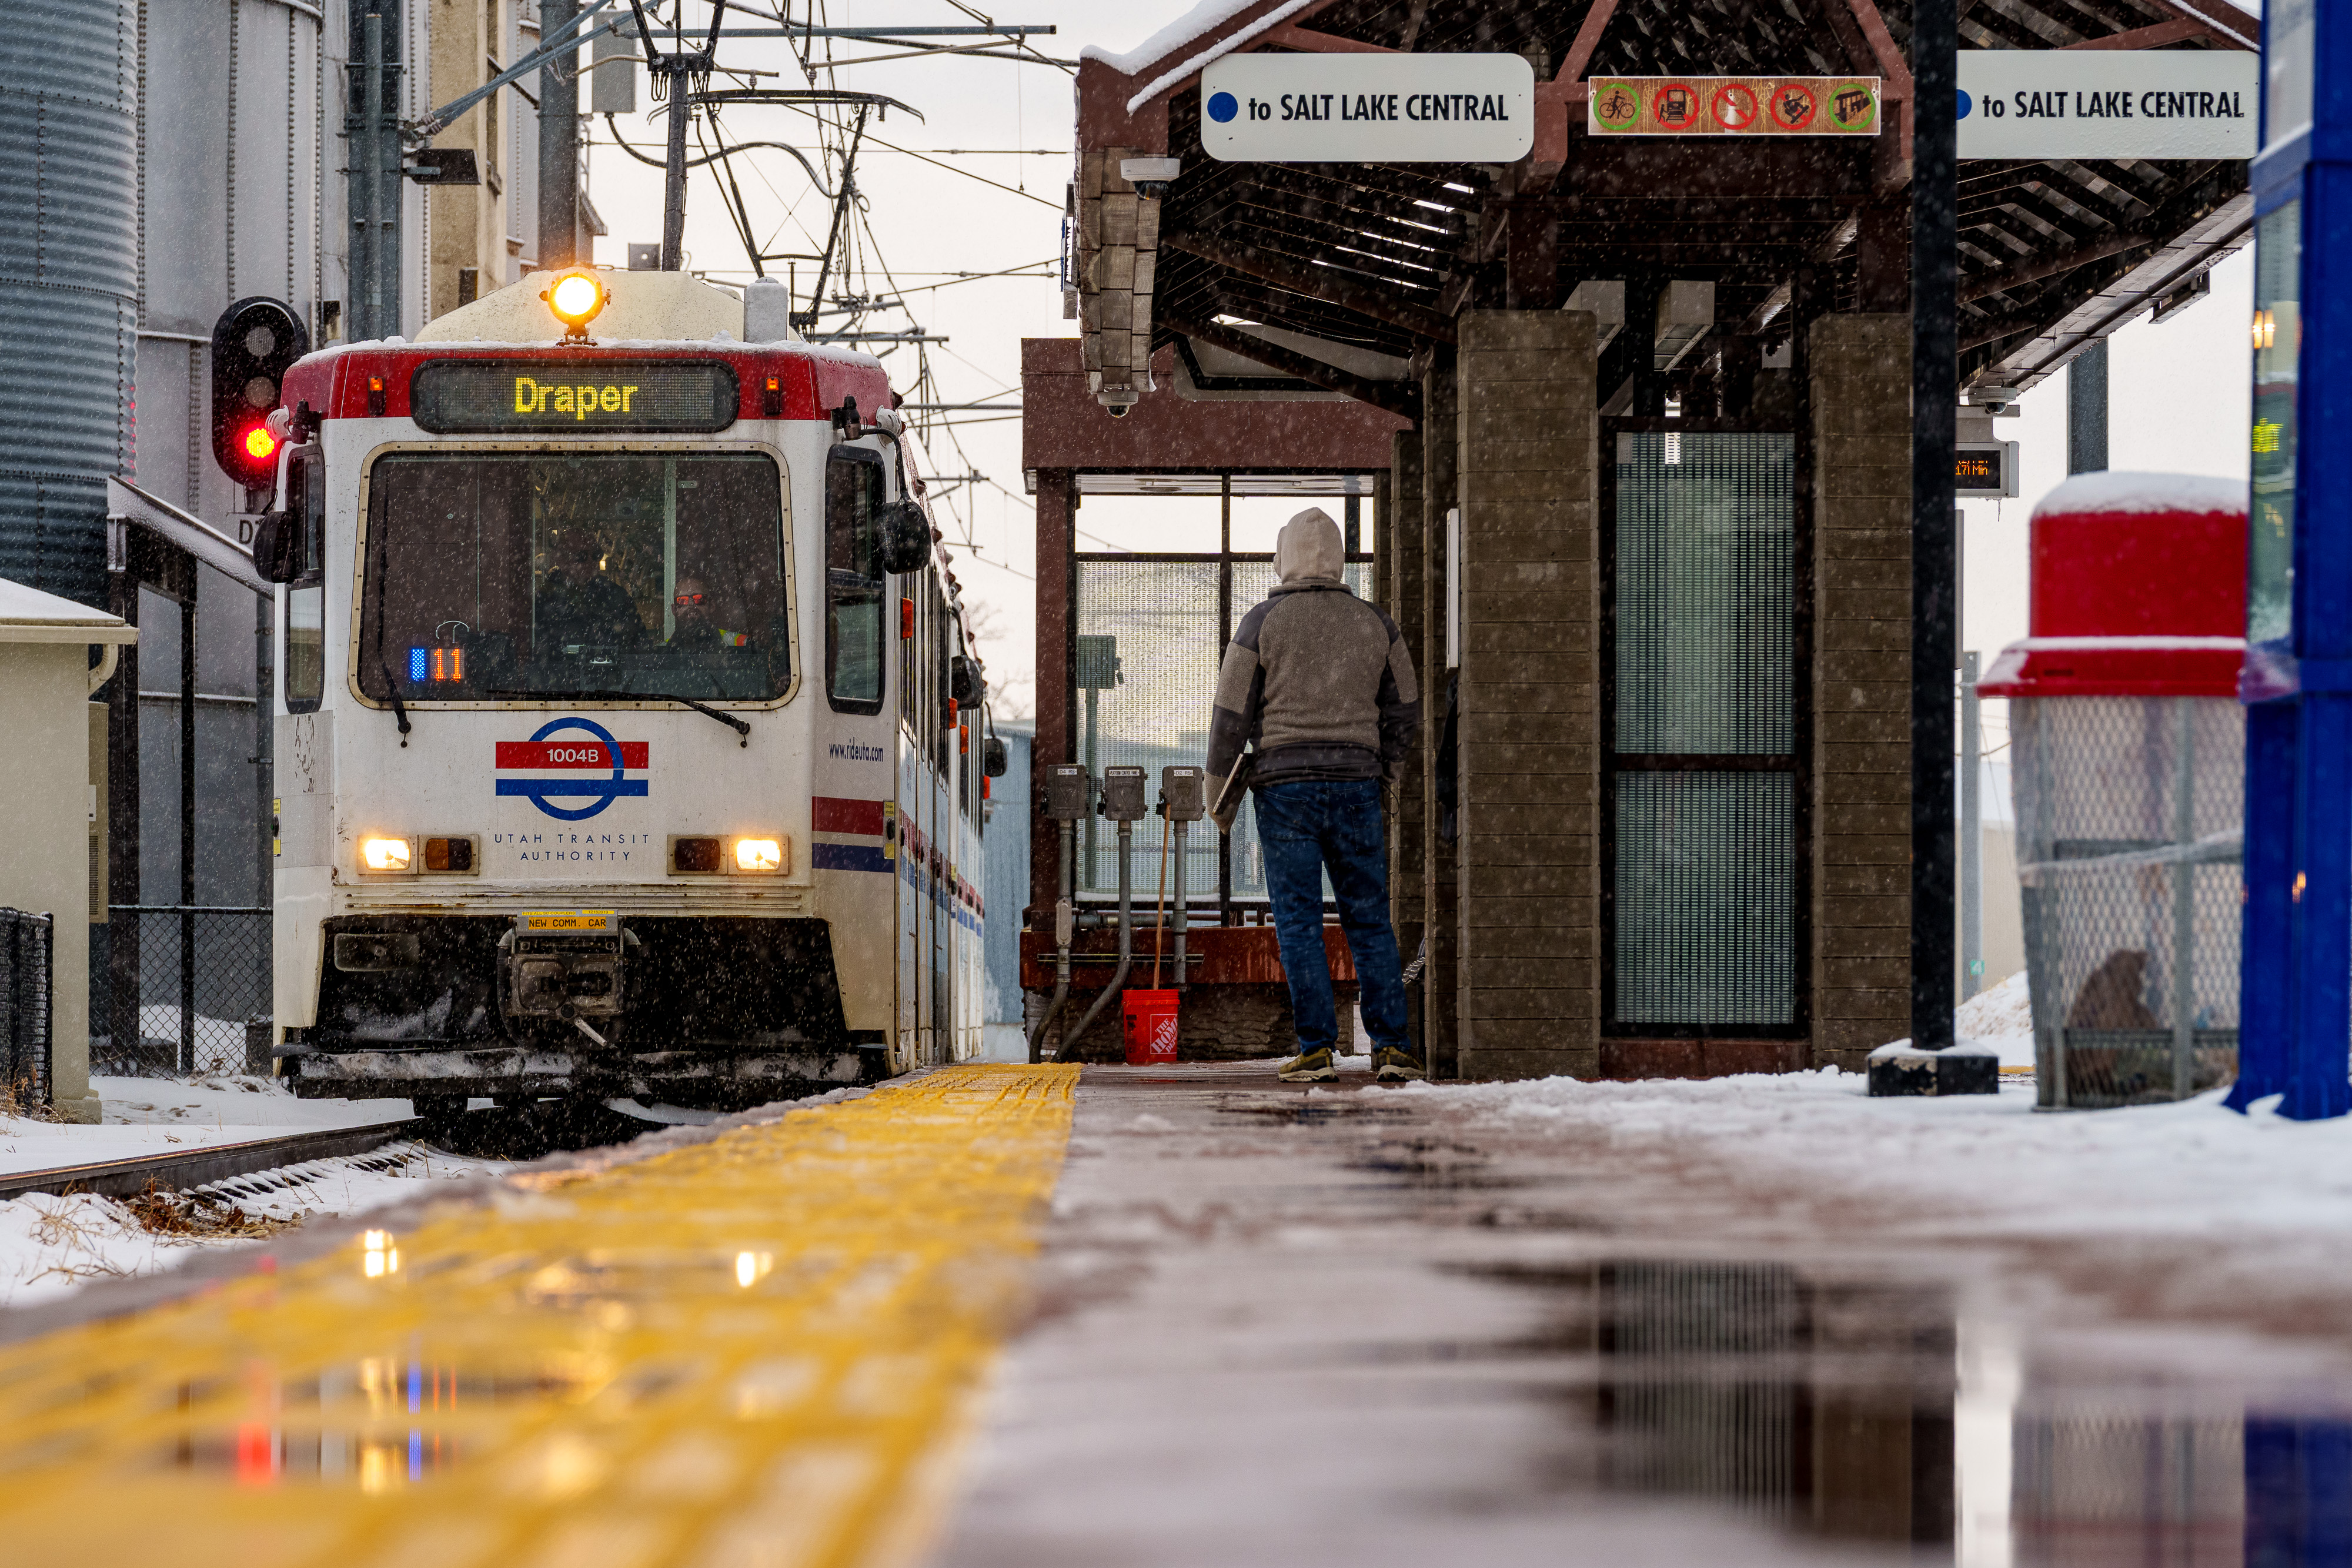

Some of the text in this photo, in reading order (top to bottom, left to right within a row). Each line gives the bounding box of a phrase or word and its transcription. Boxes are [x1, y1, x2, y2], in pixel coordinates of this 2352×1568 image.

[1248, 94, 1509, 121] to SALT LAKE CENTRAL
[1982, 91, 2245, 118] to SALT LAKE CENTRAL
[515, 377, 638, 420] Draper
[434, 648, 462, 680] 11
[547, 748, 599, 763] 1004B
[828, 736, 884, 763] www.rideuta.com
[495, 834, 649, 844] UTAH TRANSIT
[520, 851, 630, 861] AUTHORITY
[529, 919, 606, 927] NEW COMM. CAR
[1151, 1015, 1177, 1054] HOM
[1154, 1018, 1171, 1035] THE
